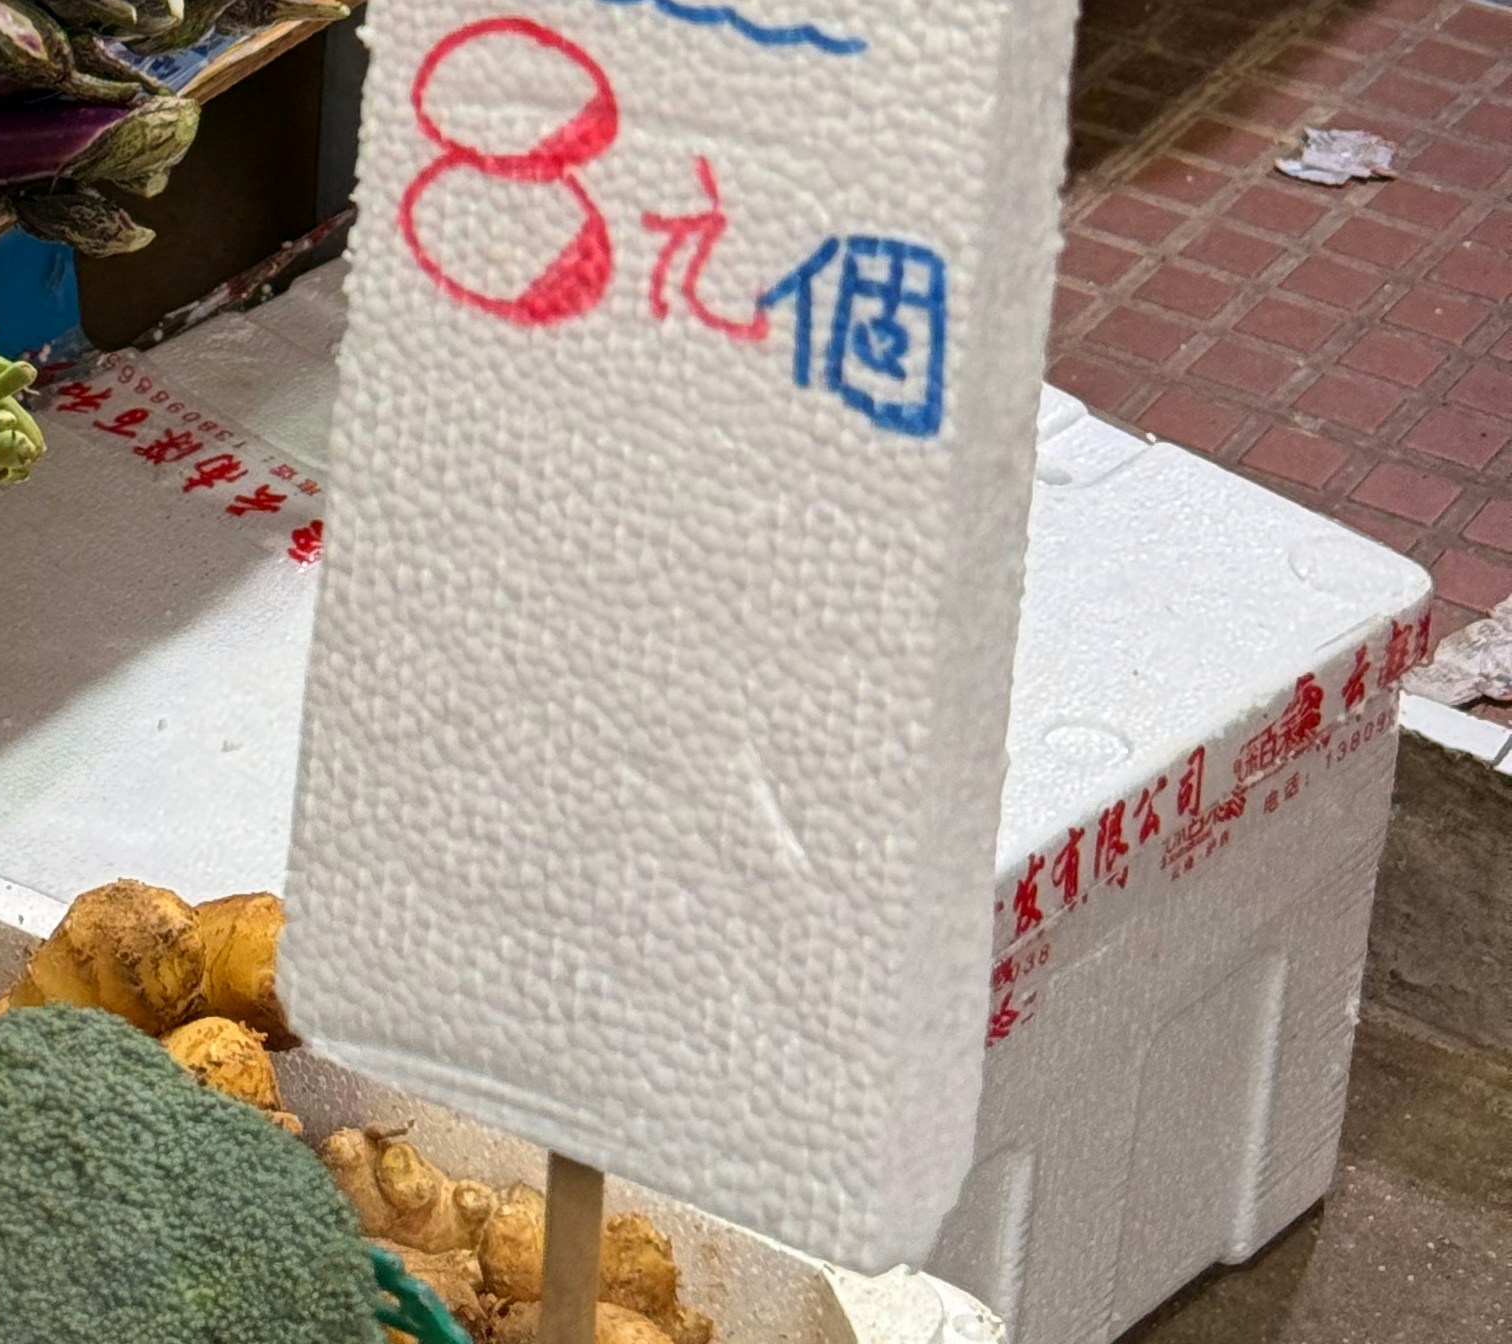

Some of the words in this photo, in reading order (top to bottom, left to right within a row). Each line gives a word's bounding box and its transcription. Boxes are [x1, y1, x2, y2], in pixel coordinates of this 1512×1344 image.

[995, 744, 1205, 937] 发有限公司
